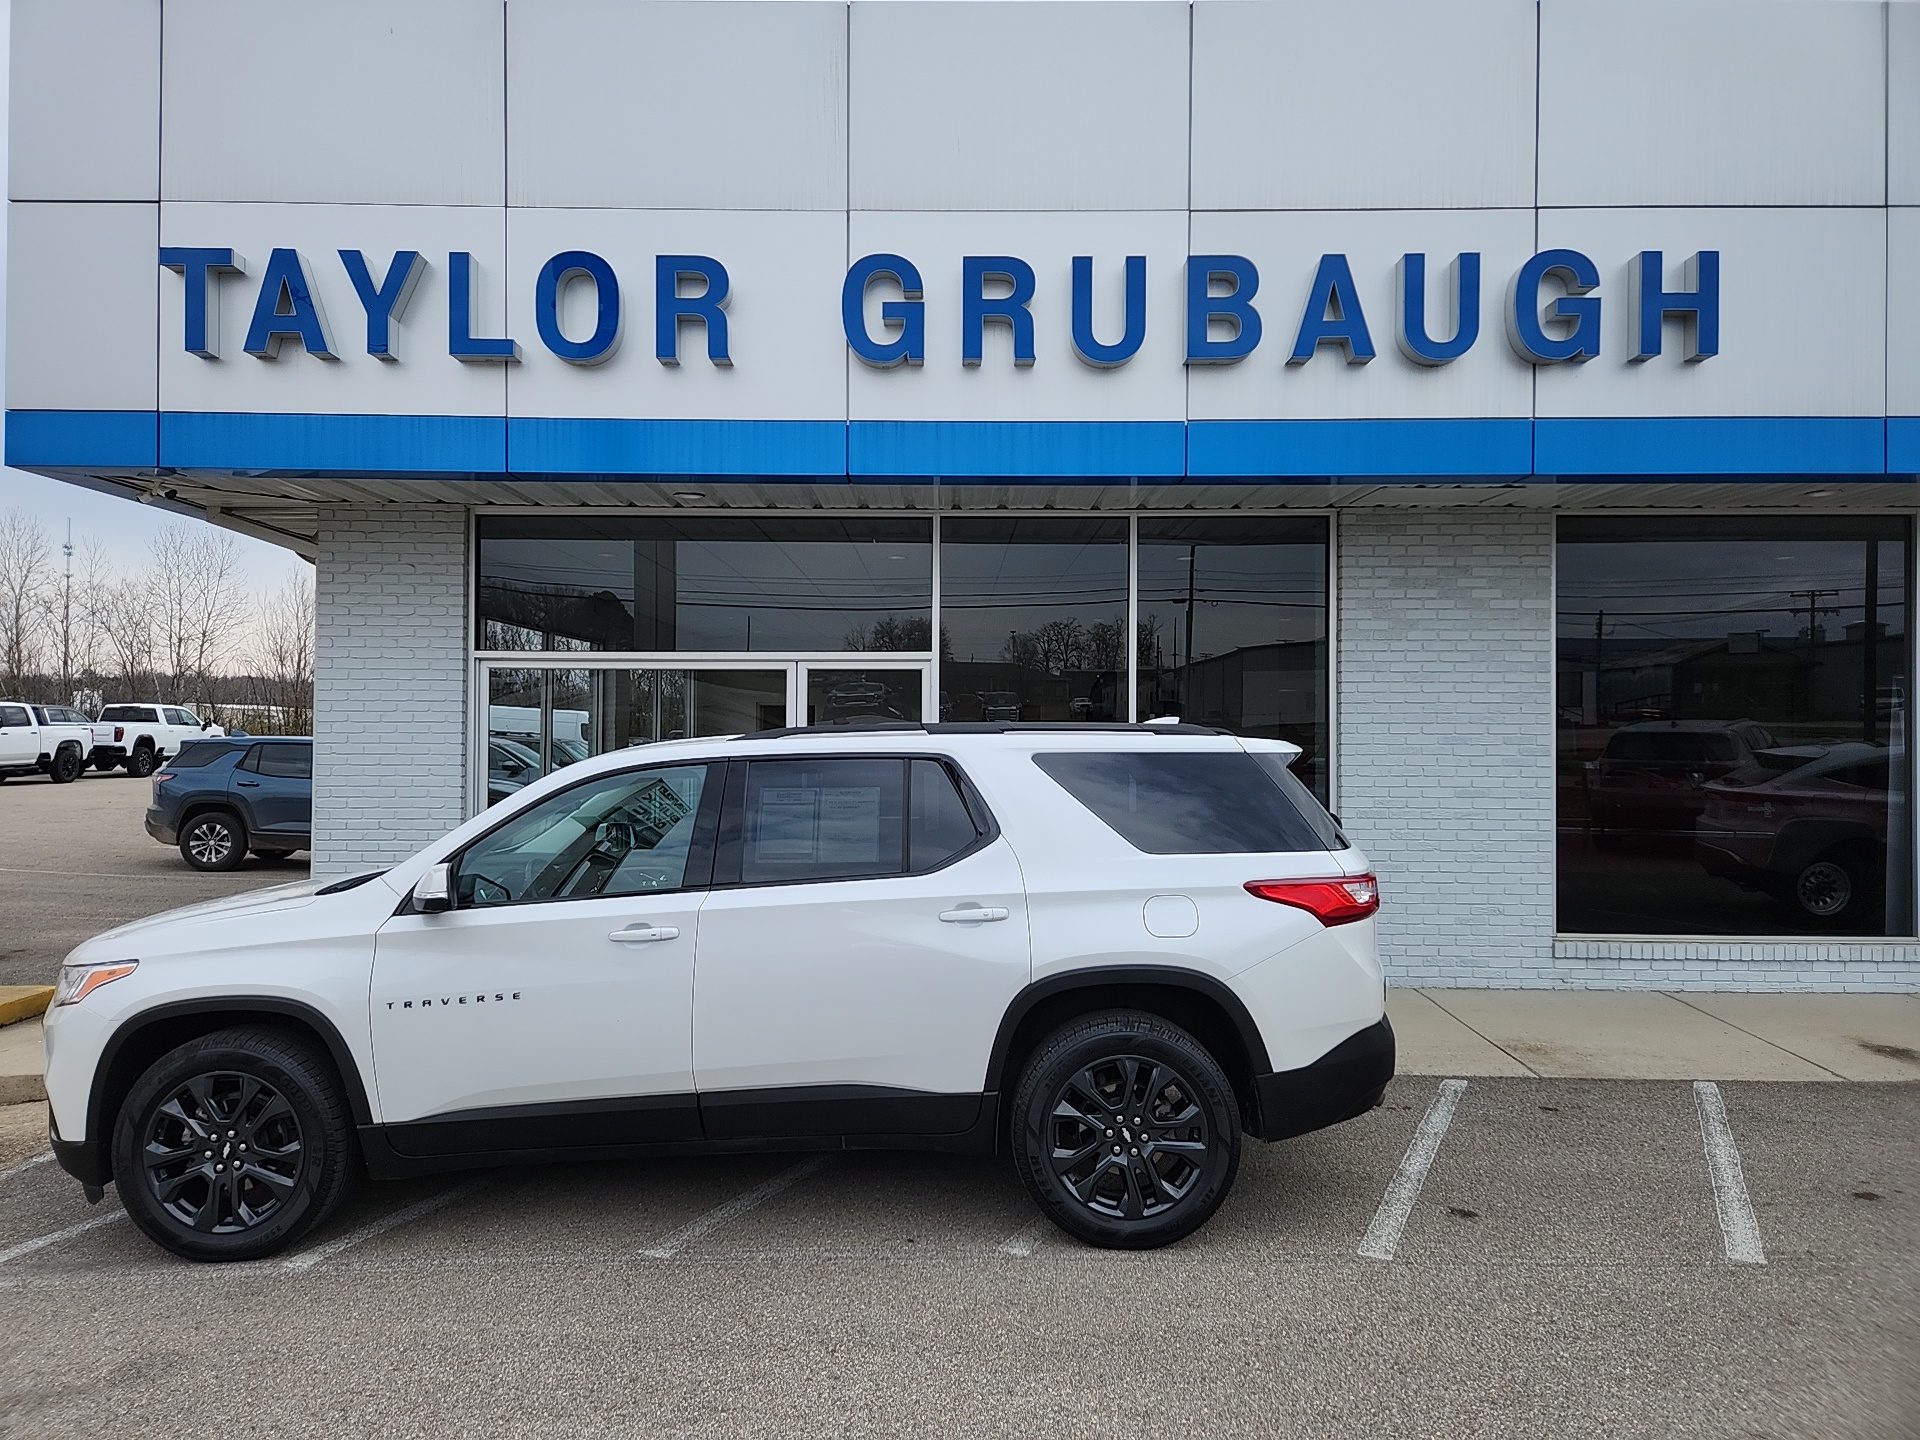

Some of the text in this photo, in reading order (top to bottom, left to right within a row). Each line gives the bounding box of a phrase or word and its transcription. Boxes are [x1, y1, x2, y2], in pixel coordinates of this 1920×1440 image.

[159, 247, 1719, 368] TAYLOR GRUBAUGH
[386, 992, 521, 1009] TRAVERSE
